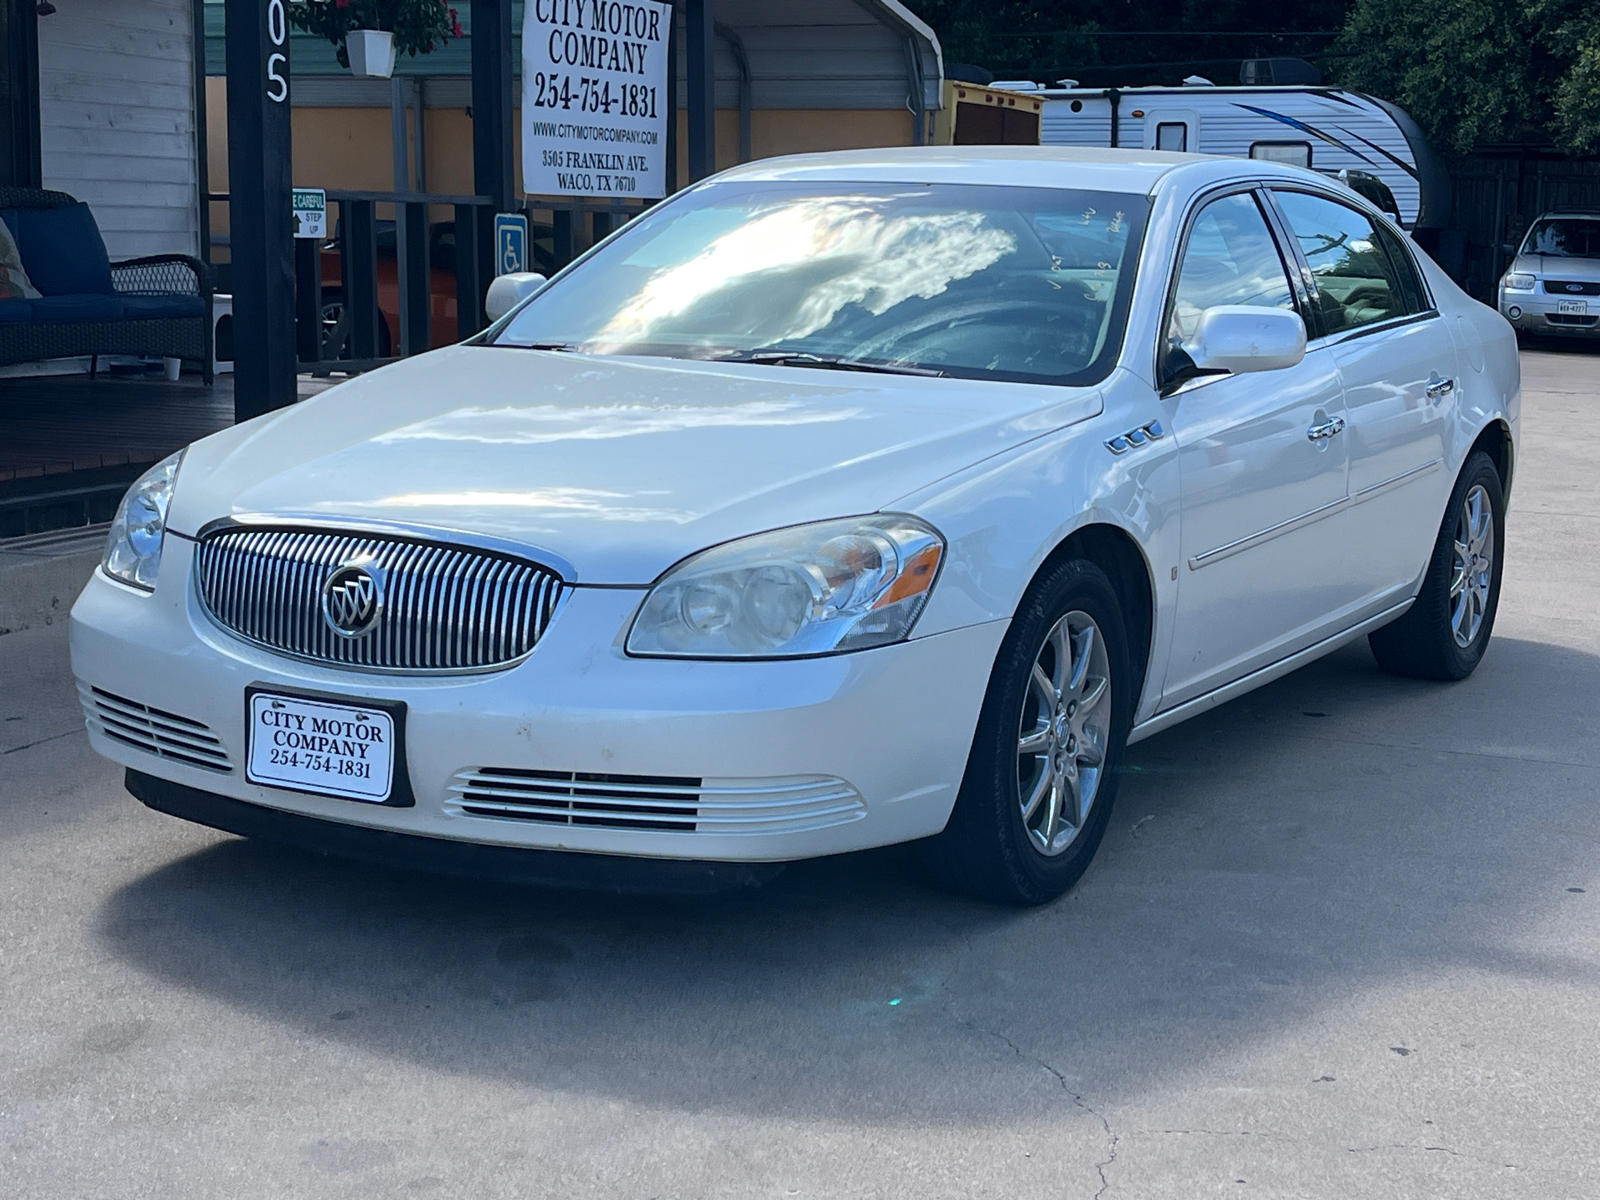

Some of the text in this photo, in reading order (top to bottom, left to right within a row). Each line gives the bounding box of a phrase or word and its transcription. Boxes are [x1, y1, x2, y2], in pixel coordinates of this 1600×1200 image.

[536, 0, 660, 42] CITY MOTOR
[549, 29, 647, 75] COMPANY
[534, 72, 657, 118] 254-754-1831
[533, 121, 658, 145] WWW.CITYMOTORCOMPANY.COM
[542, 150, 649, 172] 3505 FRANKLIN AVE.
[557, 173, 636, 193] WACO, TX 76710
[298, 194, 324, 209] CAREFUL
[305, 212, 322, 222] STEP
[309, 225, 319, 235] UP
[261, 710, 385, 743] CITY MOTOR
[273, 730, 370, 759] COMPANY
[270, 748, 371, 779] 254-754-1831
